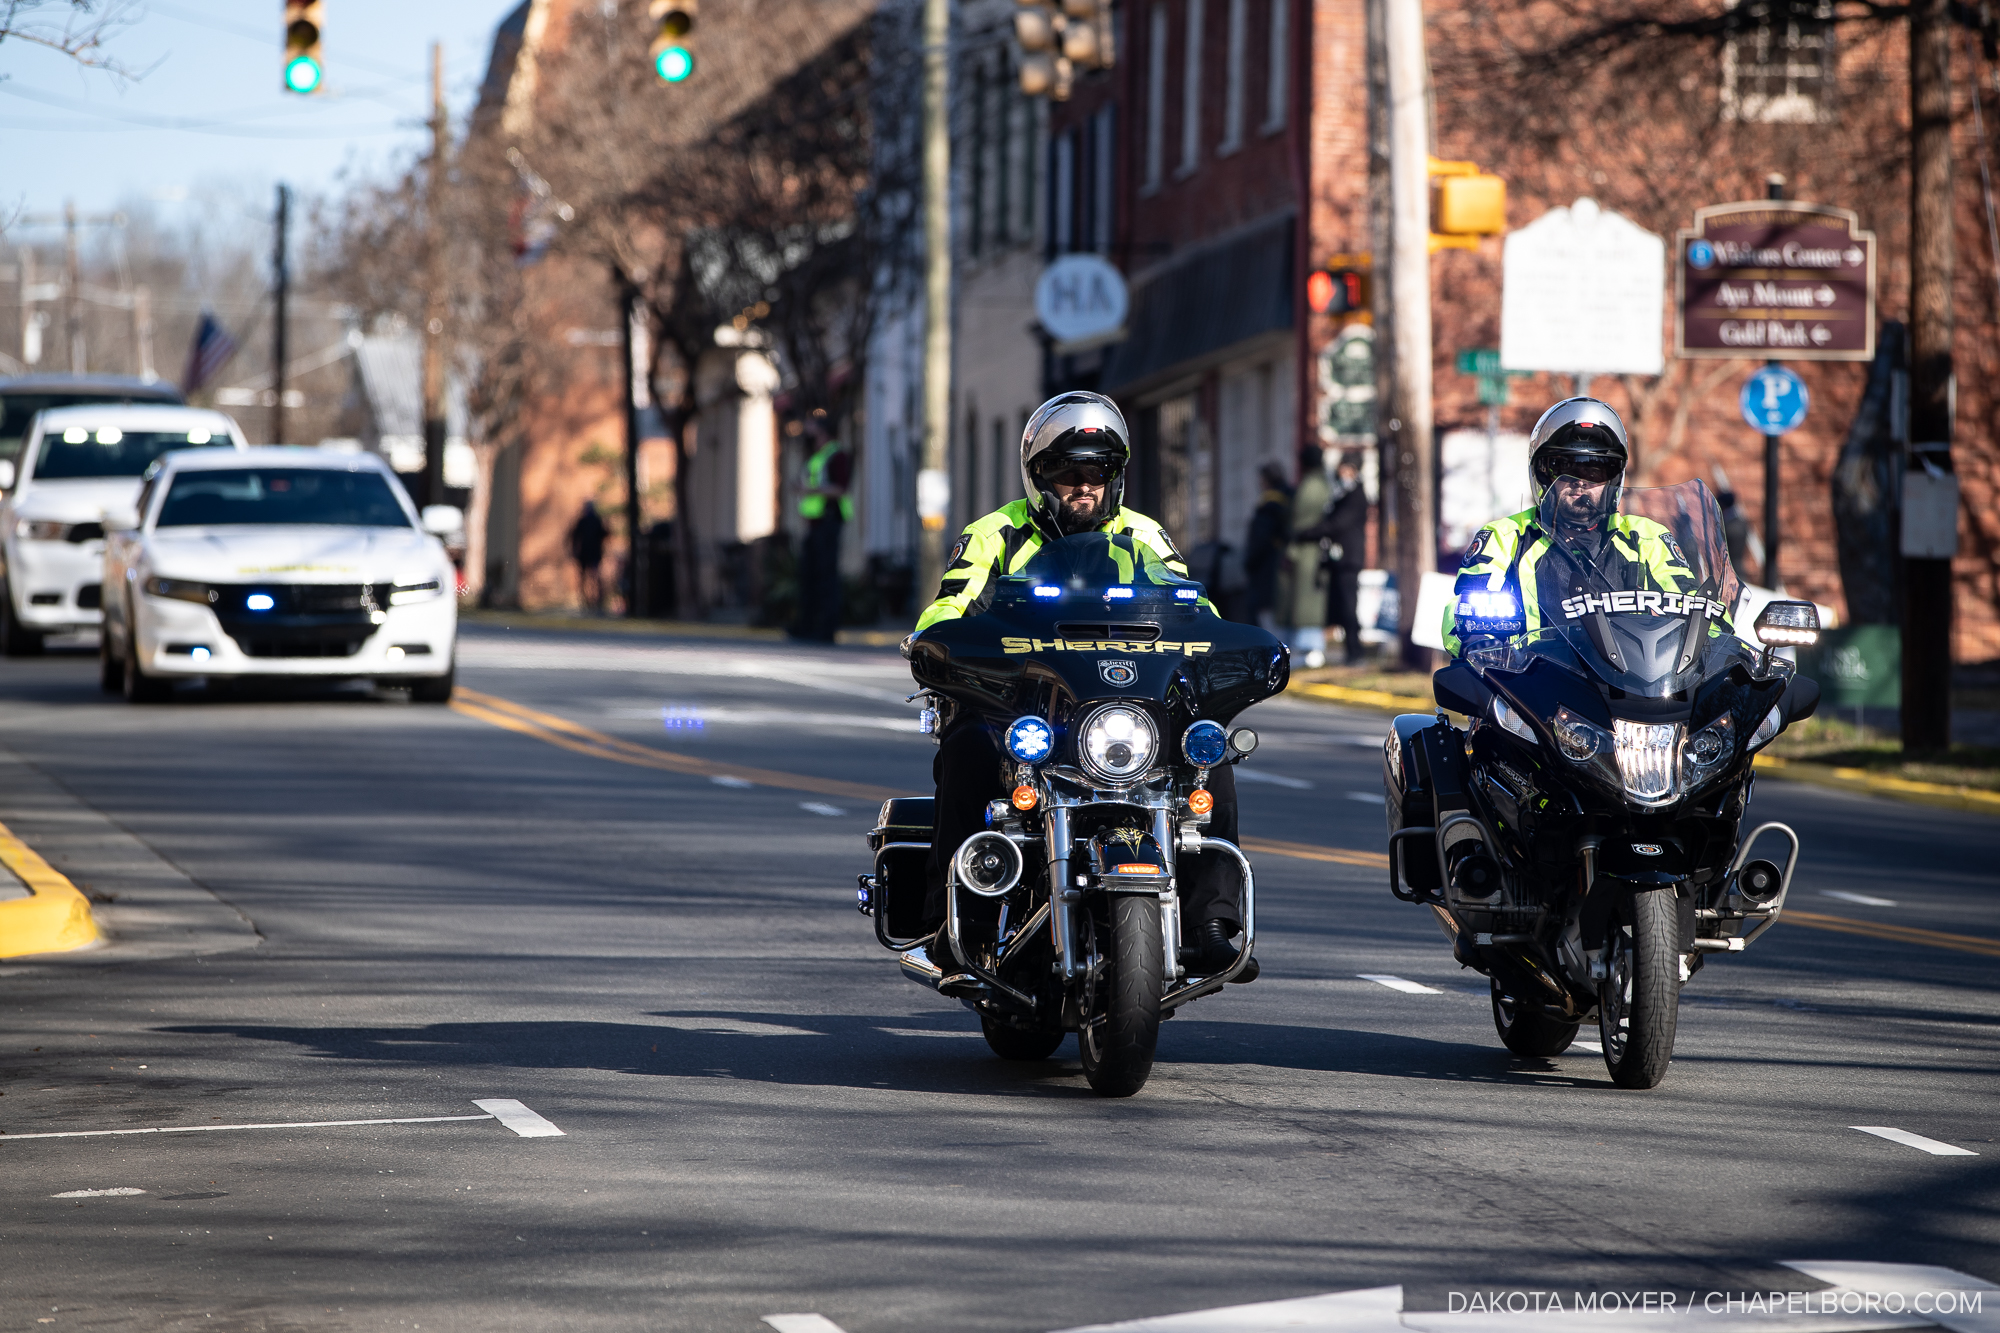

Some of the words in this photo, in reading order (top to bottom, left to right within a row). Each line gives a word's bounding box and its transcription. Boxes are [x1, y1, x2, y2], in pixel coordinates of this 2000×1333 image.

[1762, 375, 1792, 409] P
[1561, 591, 1726, 619] SHERIFF
[1001, 637, 1212, 657] SHERIFF
